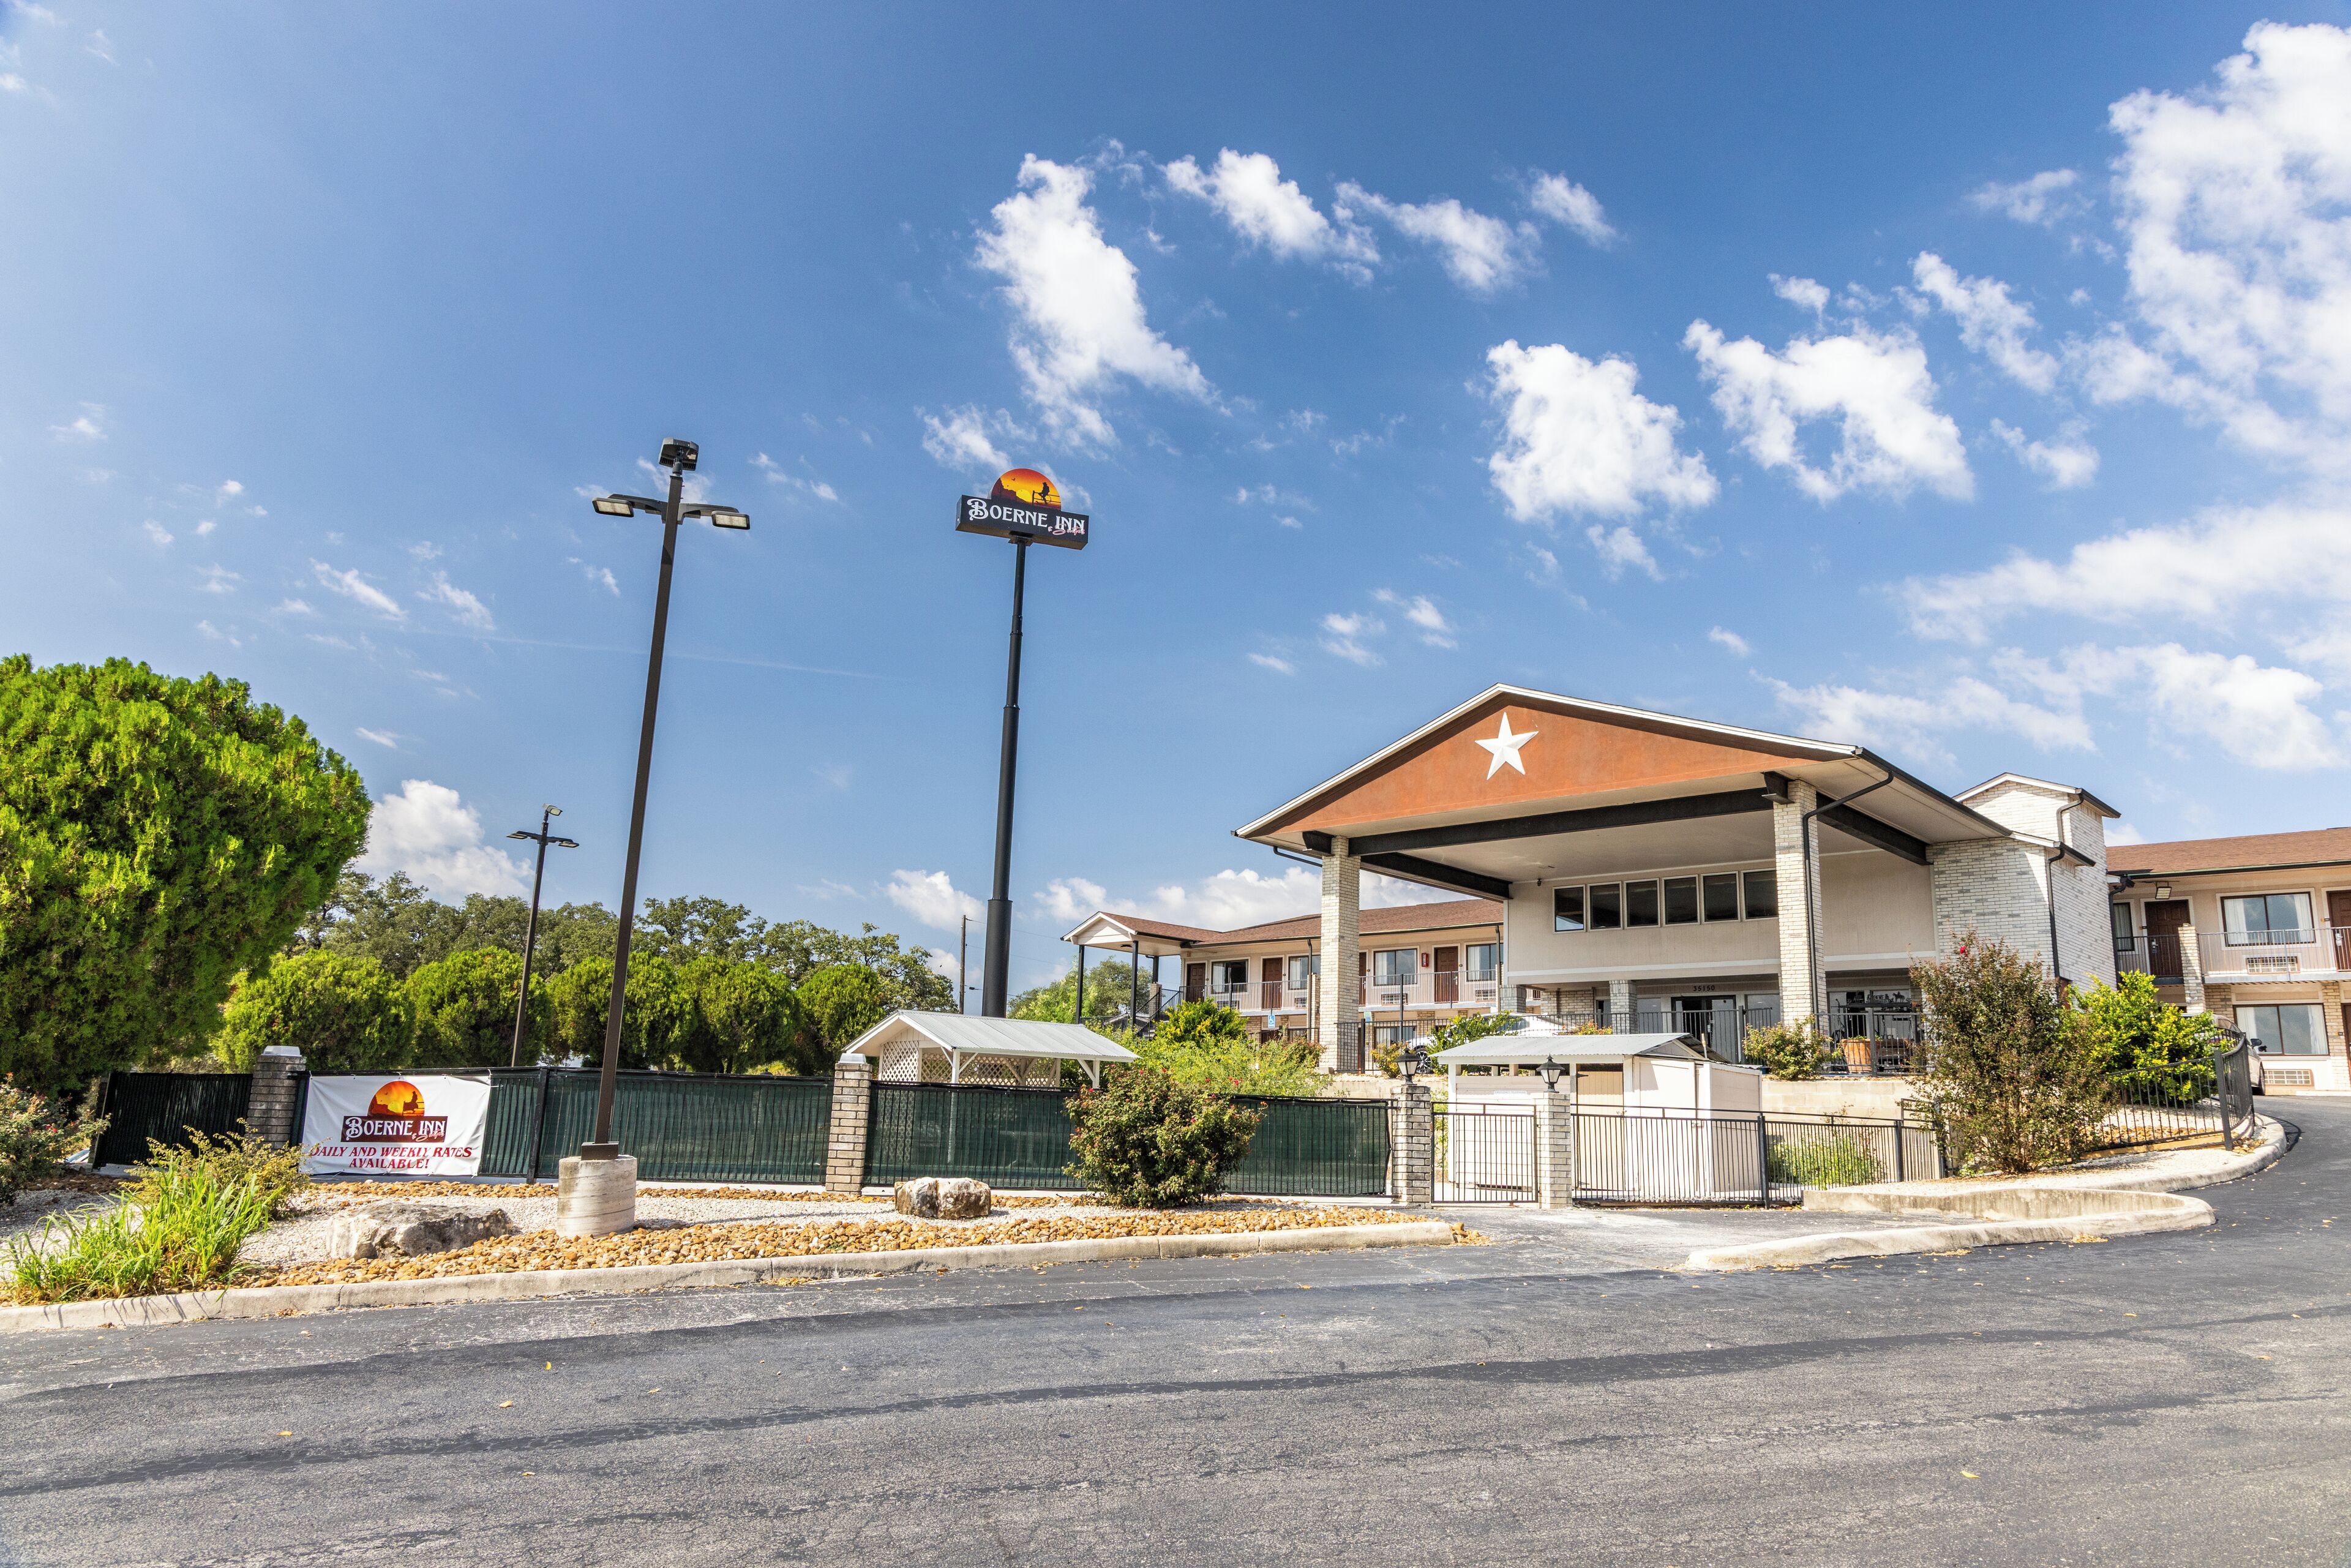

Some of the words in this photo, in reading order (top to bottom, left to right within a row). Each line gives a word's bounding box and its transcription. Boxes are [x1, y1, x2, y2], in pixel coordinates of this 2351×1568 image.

[967, 498, 1048, 527] BOERNE
[1056, 516, 1085, 532] INN
[345, 1117, 414, 1141] BOERNE
[419, 1120, 446, 1136] INN
[348, 1147, 377, 1157] AND
[380, 1147, 431, 1157] WEEKLY
[432, 1147, 473, 1158] RATES
[349, 1158, 429, 1169] AVAILABLE!
